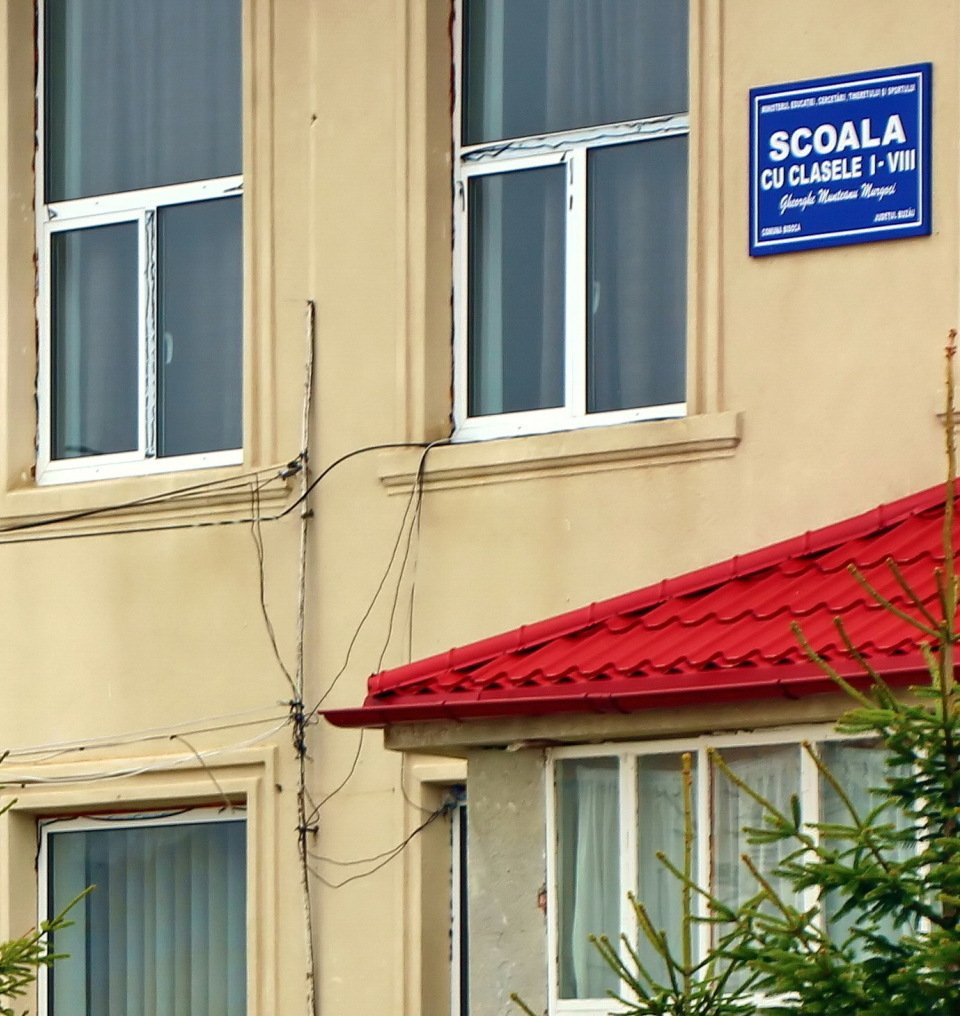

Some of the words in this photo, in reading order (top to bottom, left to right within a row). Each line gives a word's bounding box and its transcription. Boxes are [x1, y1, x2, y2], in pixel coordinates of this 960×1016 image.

[769, 114, 907, 161] SCOALA
[761, 166, 784, 190] CU
[789, 156, 862, 186] CLASELE
[779, 190, 816, 216] Gheorghe
[817, 188, 859, 204] Munteanu
[761, 226, 783, 237] COMUNA
